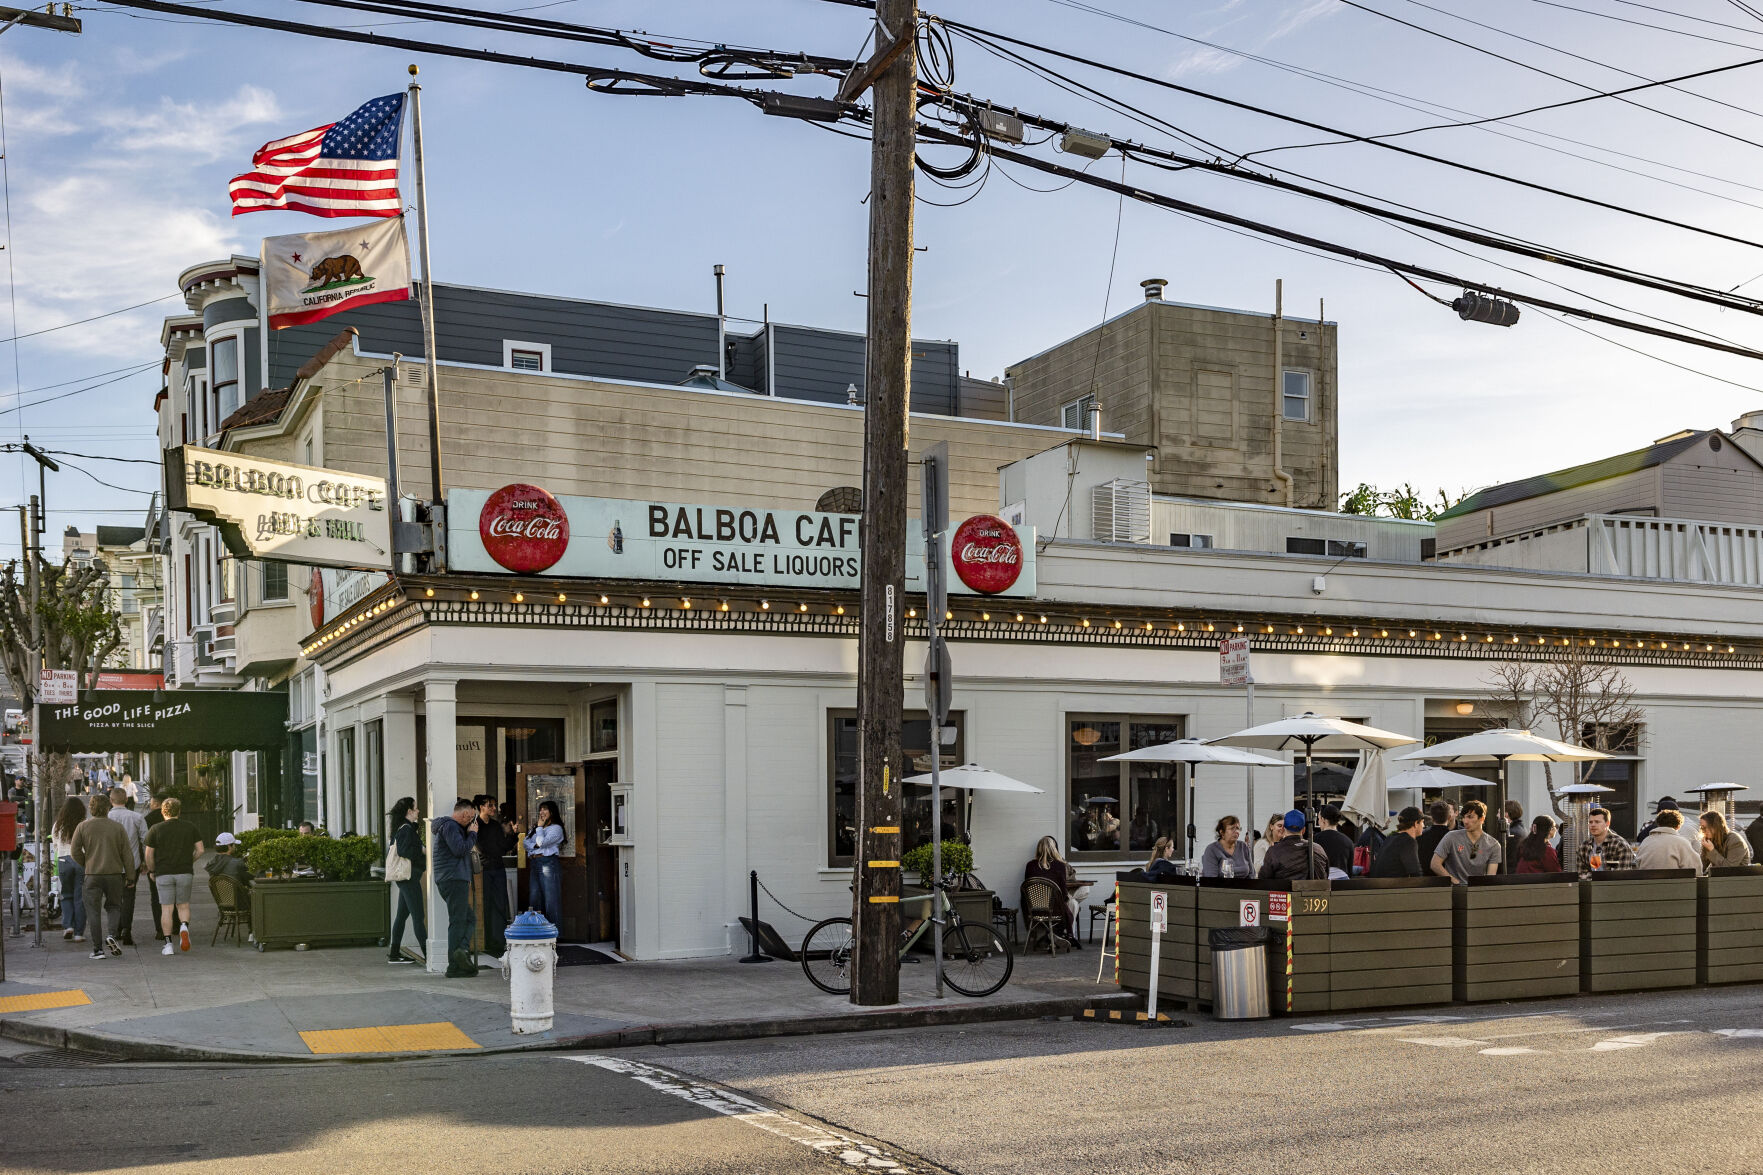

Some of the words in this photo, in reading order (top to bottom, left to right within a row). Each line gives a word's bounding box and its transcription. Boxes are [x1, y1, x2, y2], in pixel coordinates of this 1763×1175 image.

[303, 293, 344, 306] CALIFORNIA
[345, 282, 375, 297] REPUBLIC
[512, 500, 538, 509] DRINK
[489, 515, 561, 539] Coca-Cola
[649, 505, 781, 544] BALBOA
[795, 514, 862, 549] CAF
[980, 529, 1001, 538] DRINK
[961, 542, 1017, 564] Coca-Cola
[663, 548, 702, 569] OFF
[712, 551, 765, 573] SALE
[774, 554, 858, 577] LIQUORS
[1230, 641, 1248, 652] PARKING
[41, 670, 52, 680] NO
[54, 706, 80, 720] THE
[84, 703, 121, 720] GOOD
[124, 705, 151, 720] LIFE
[155, 703, 191, 721] PIZZA
[1302, 898, 1328, 913] 3199
